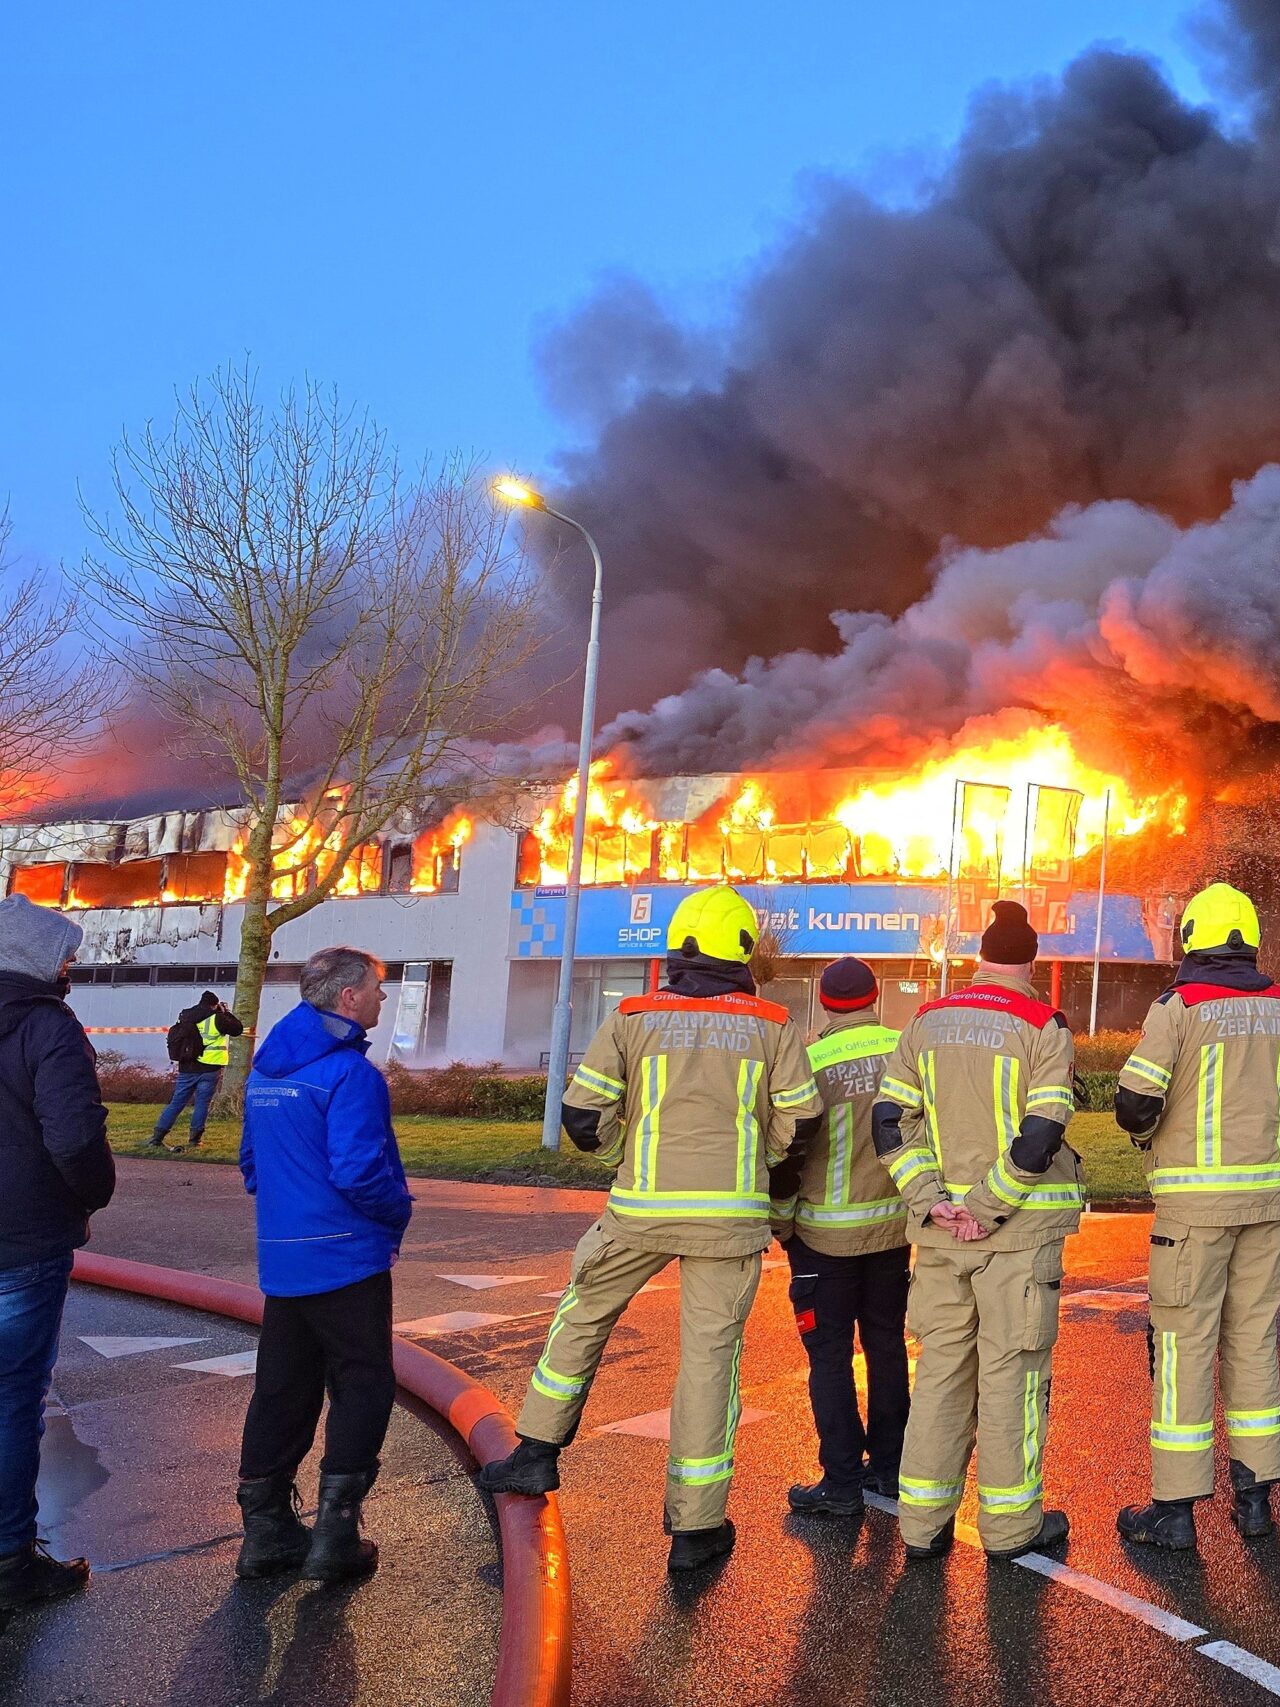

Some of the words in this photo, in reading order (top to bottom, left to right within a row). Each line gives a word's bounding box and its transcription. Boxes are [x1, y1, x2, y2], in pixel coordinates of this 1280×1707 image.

[633, 896, 649, 920] 6
[808, 908, 919, 931] kunnen
[618, 928, 662, 942] SHOP
[659, 1030, 751, 1052] ZEELAND
[843, 1075, 876, 1098] ZEE
